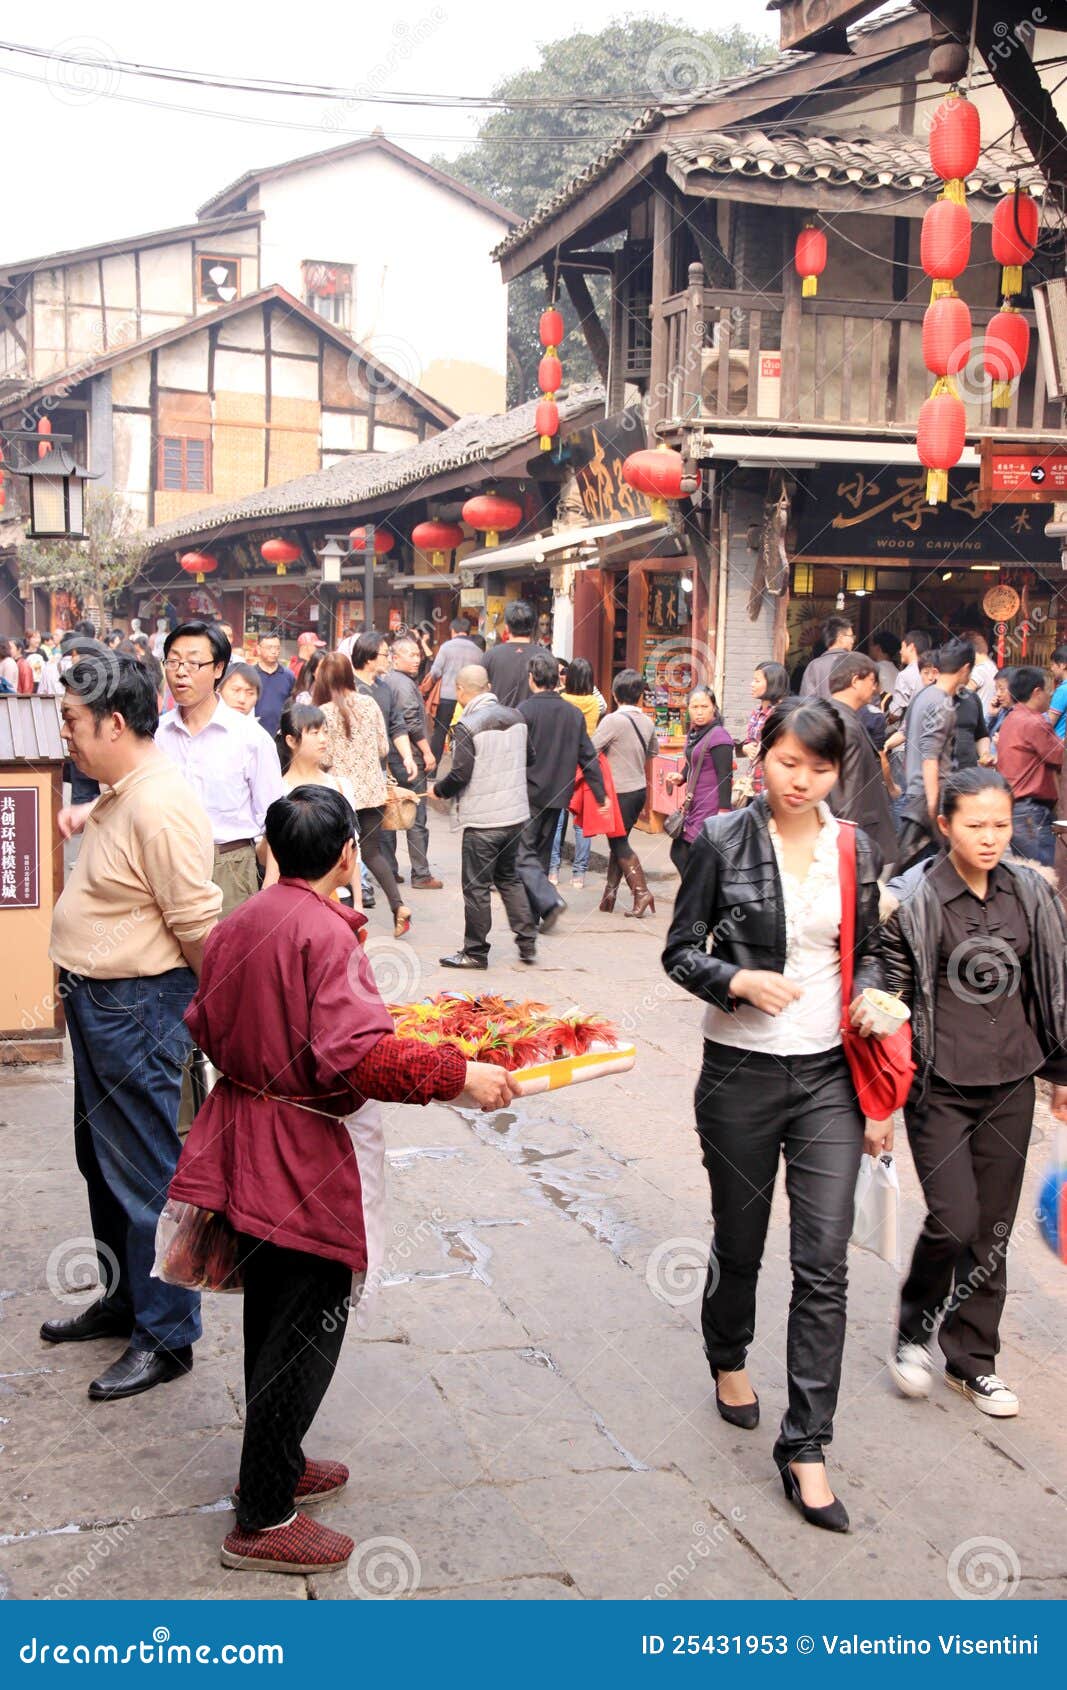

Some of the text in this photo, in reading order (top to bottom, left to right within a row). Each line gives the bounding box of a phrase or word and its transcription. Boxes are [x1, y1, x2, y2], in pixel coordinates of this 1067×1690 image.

[876, 540, 982, 550] WOOD CARVING
[0, 796, 17, 899] 共创环保模范城
